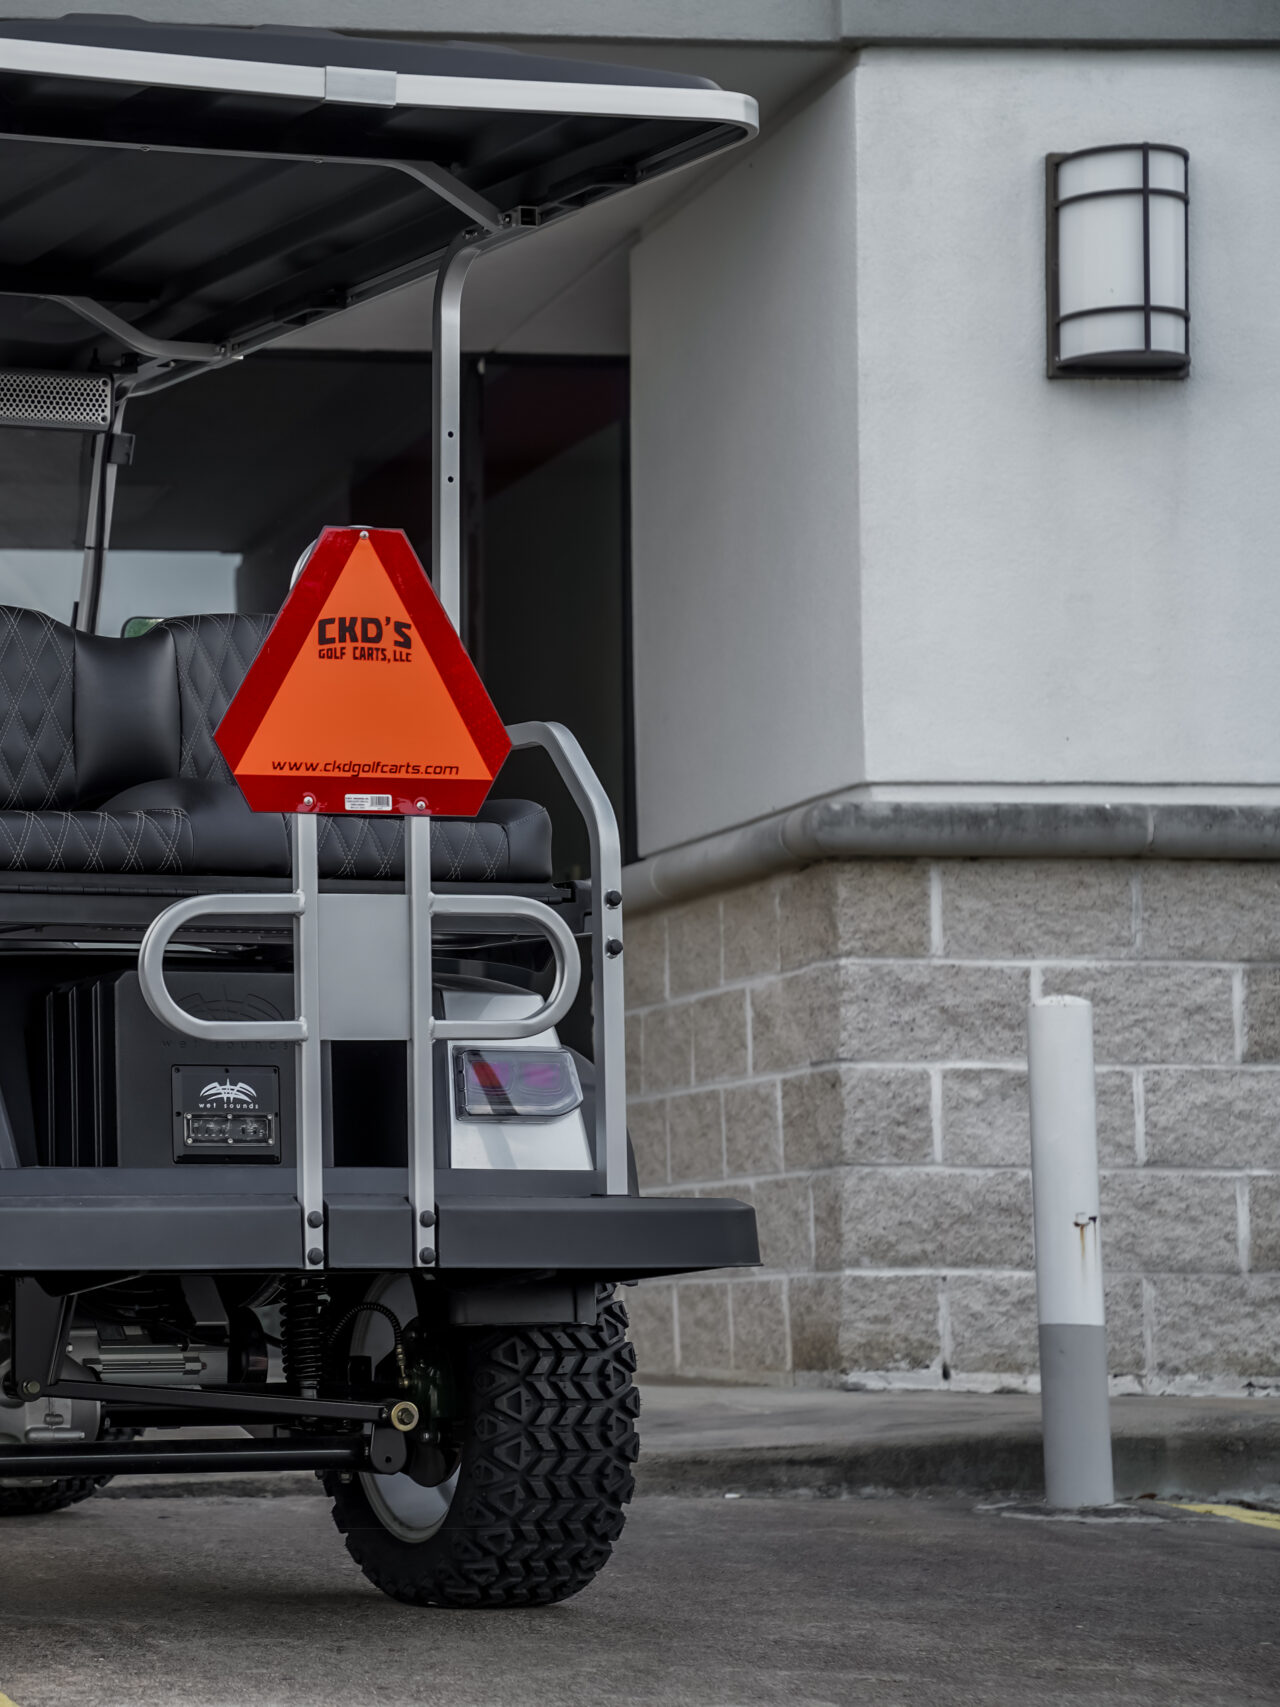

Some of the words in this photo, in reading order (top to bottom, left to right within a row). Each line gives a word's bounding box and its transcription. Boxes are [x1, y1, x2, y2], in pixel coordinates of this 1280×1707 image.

[318, 616, 412, 650] CKD'S
[318, 646, 346, 661] GOLF
[271, 760, 459, 778] www.ckdgolfcarts.com
